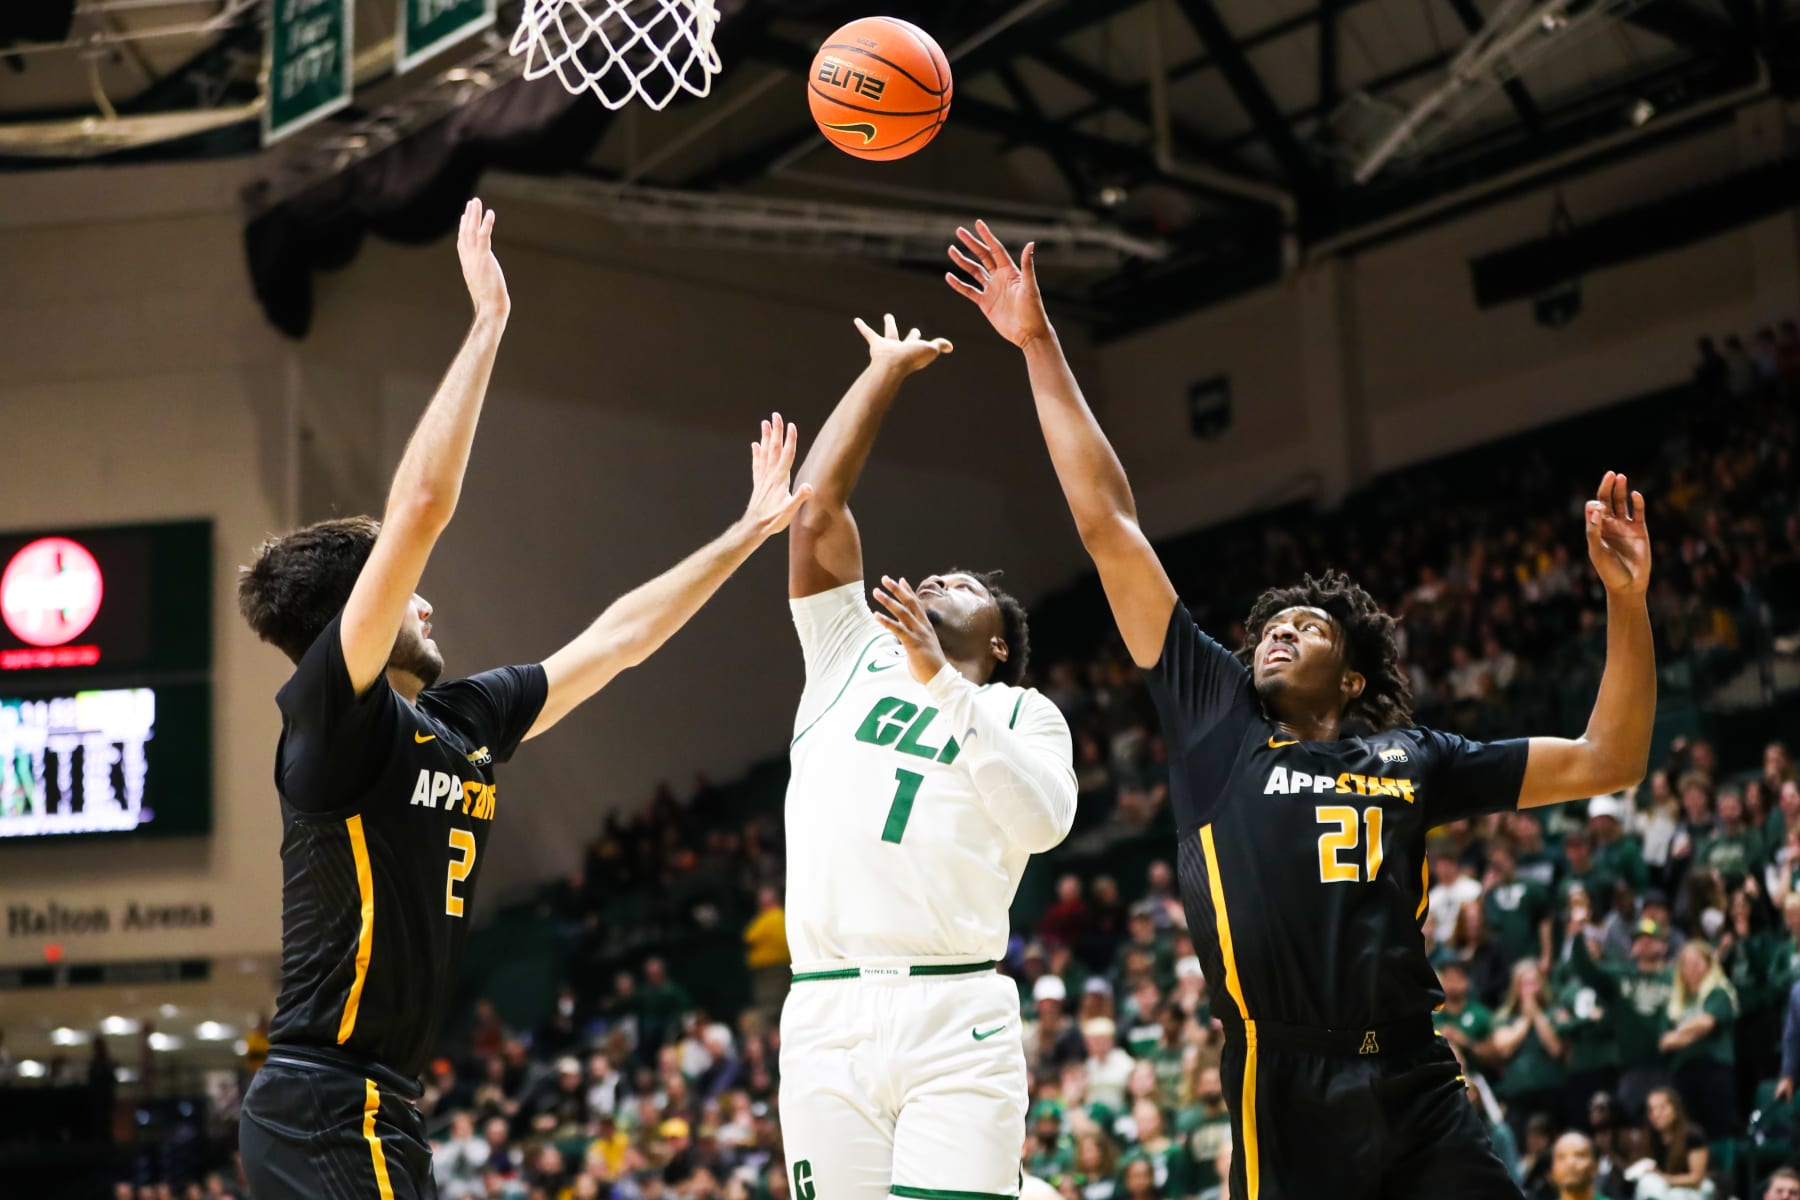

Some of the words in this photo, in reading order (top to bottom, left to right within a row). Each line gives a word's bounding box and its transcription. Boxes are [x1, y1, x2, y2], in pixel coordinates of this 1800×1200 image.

[818, 61, 886, 101] ELITE
[881, 767, 925, 845] 1
[1315, 806, 1383, 883] 21
[445, 827, 476, 918] 2
[7, 899, 111, 931] Halton
[121, 899, 214, 926] Arena
